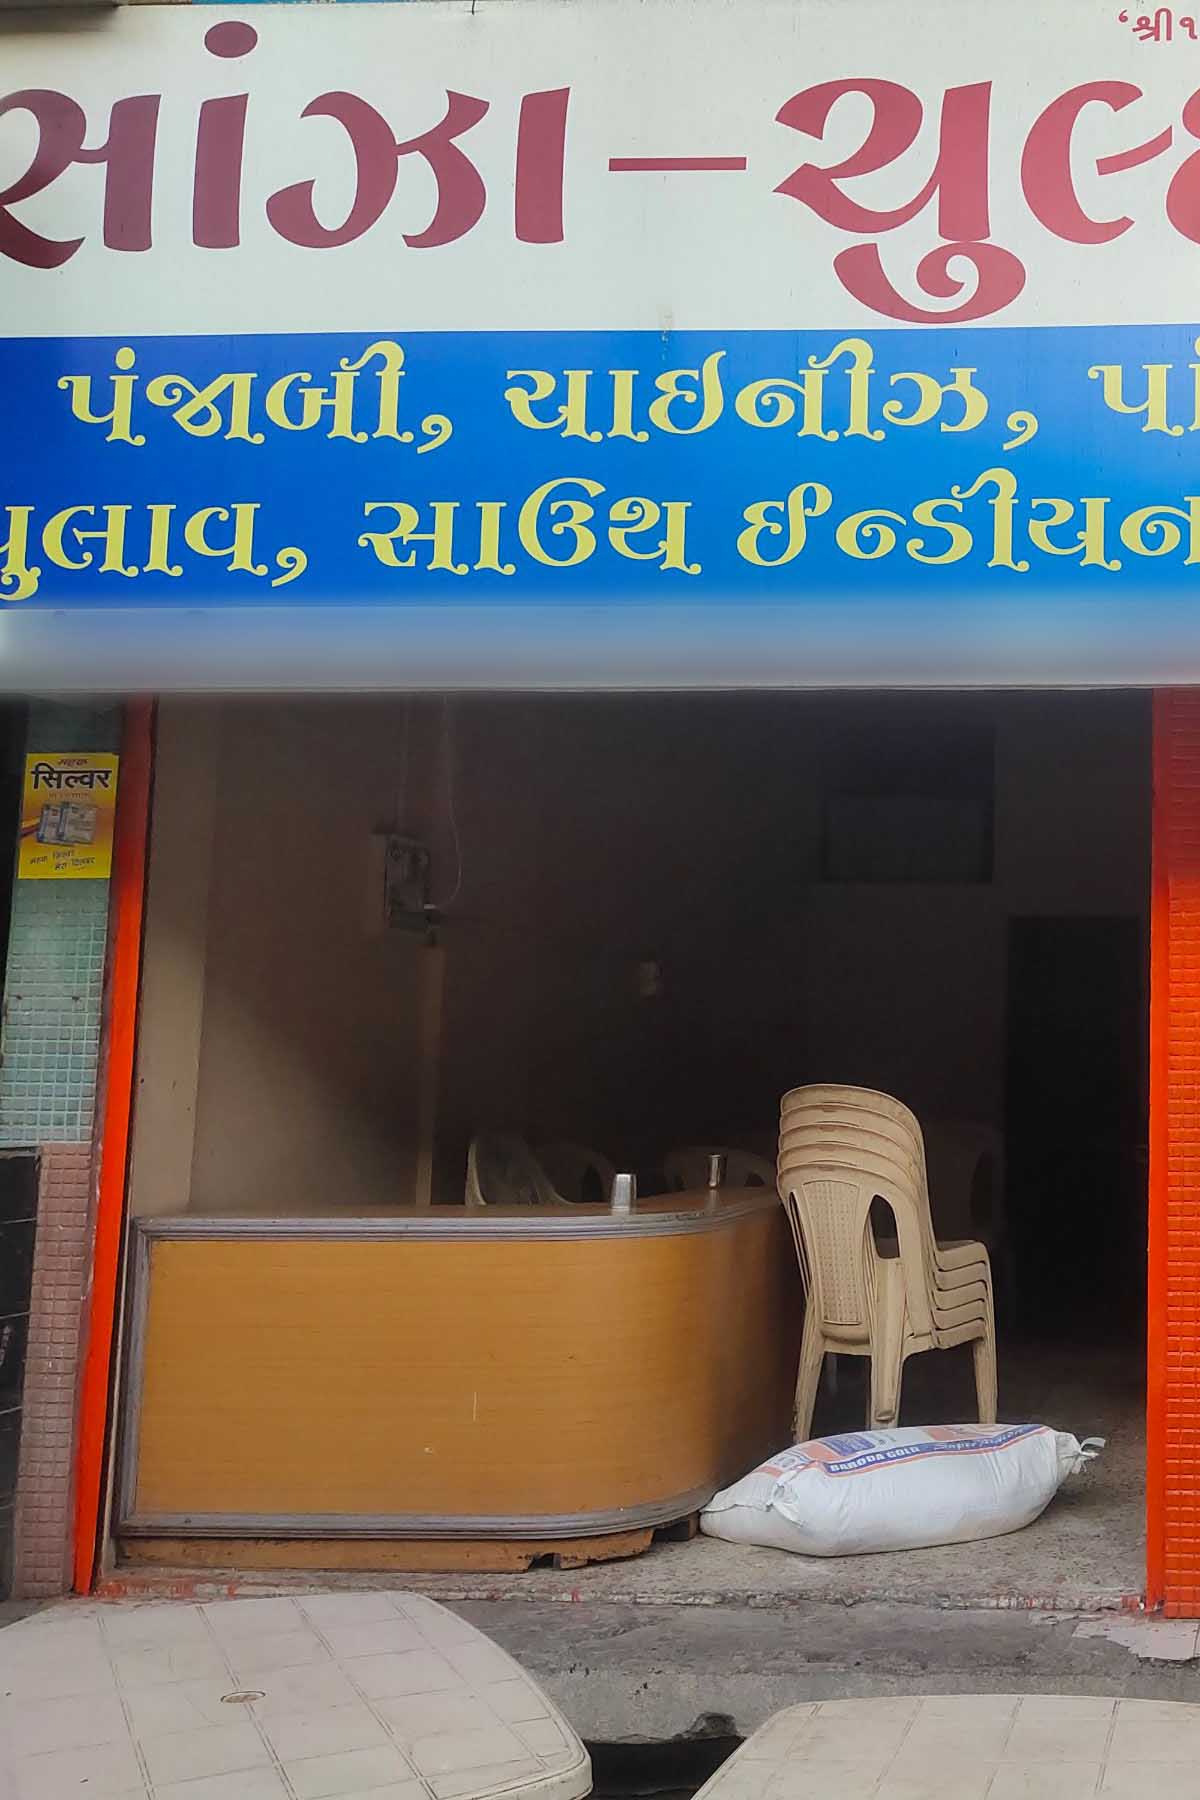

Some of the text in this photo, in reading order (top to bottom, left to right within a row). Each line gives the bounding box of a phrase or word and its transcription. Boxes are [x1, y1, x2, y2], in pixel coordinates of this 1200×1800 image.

[59, 342, 451, 452] પંજાબી,
[506, 339, 1038, 449] ચાઇનીઝ,
[359, 478, 701, 575] સાઉથ
[31, 763, 112, 788] सिल्वर
[829, 1452, 887, 1473] BARODA
[887, 1445, 920, 1461] GOLD
